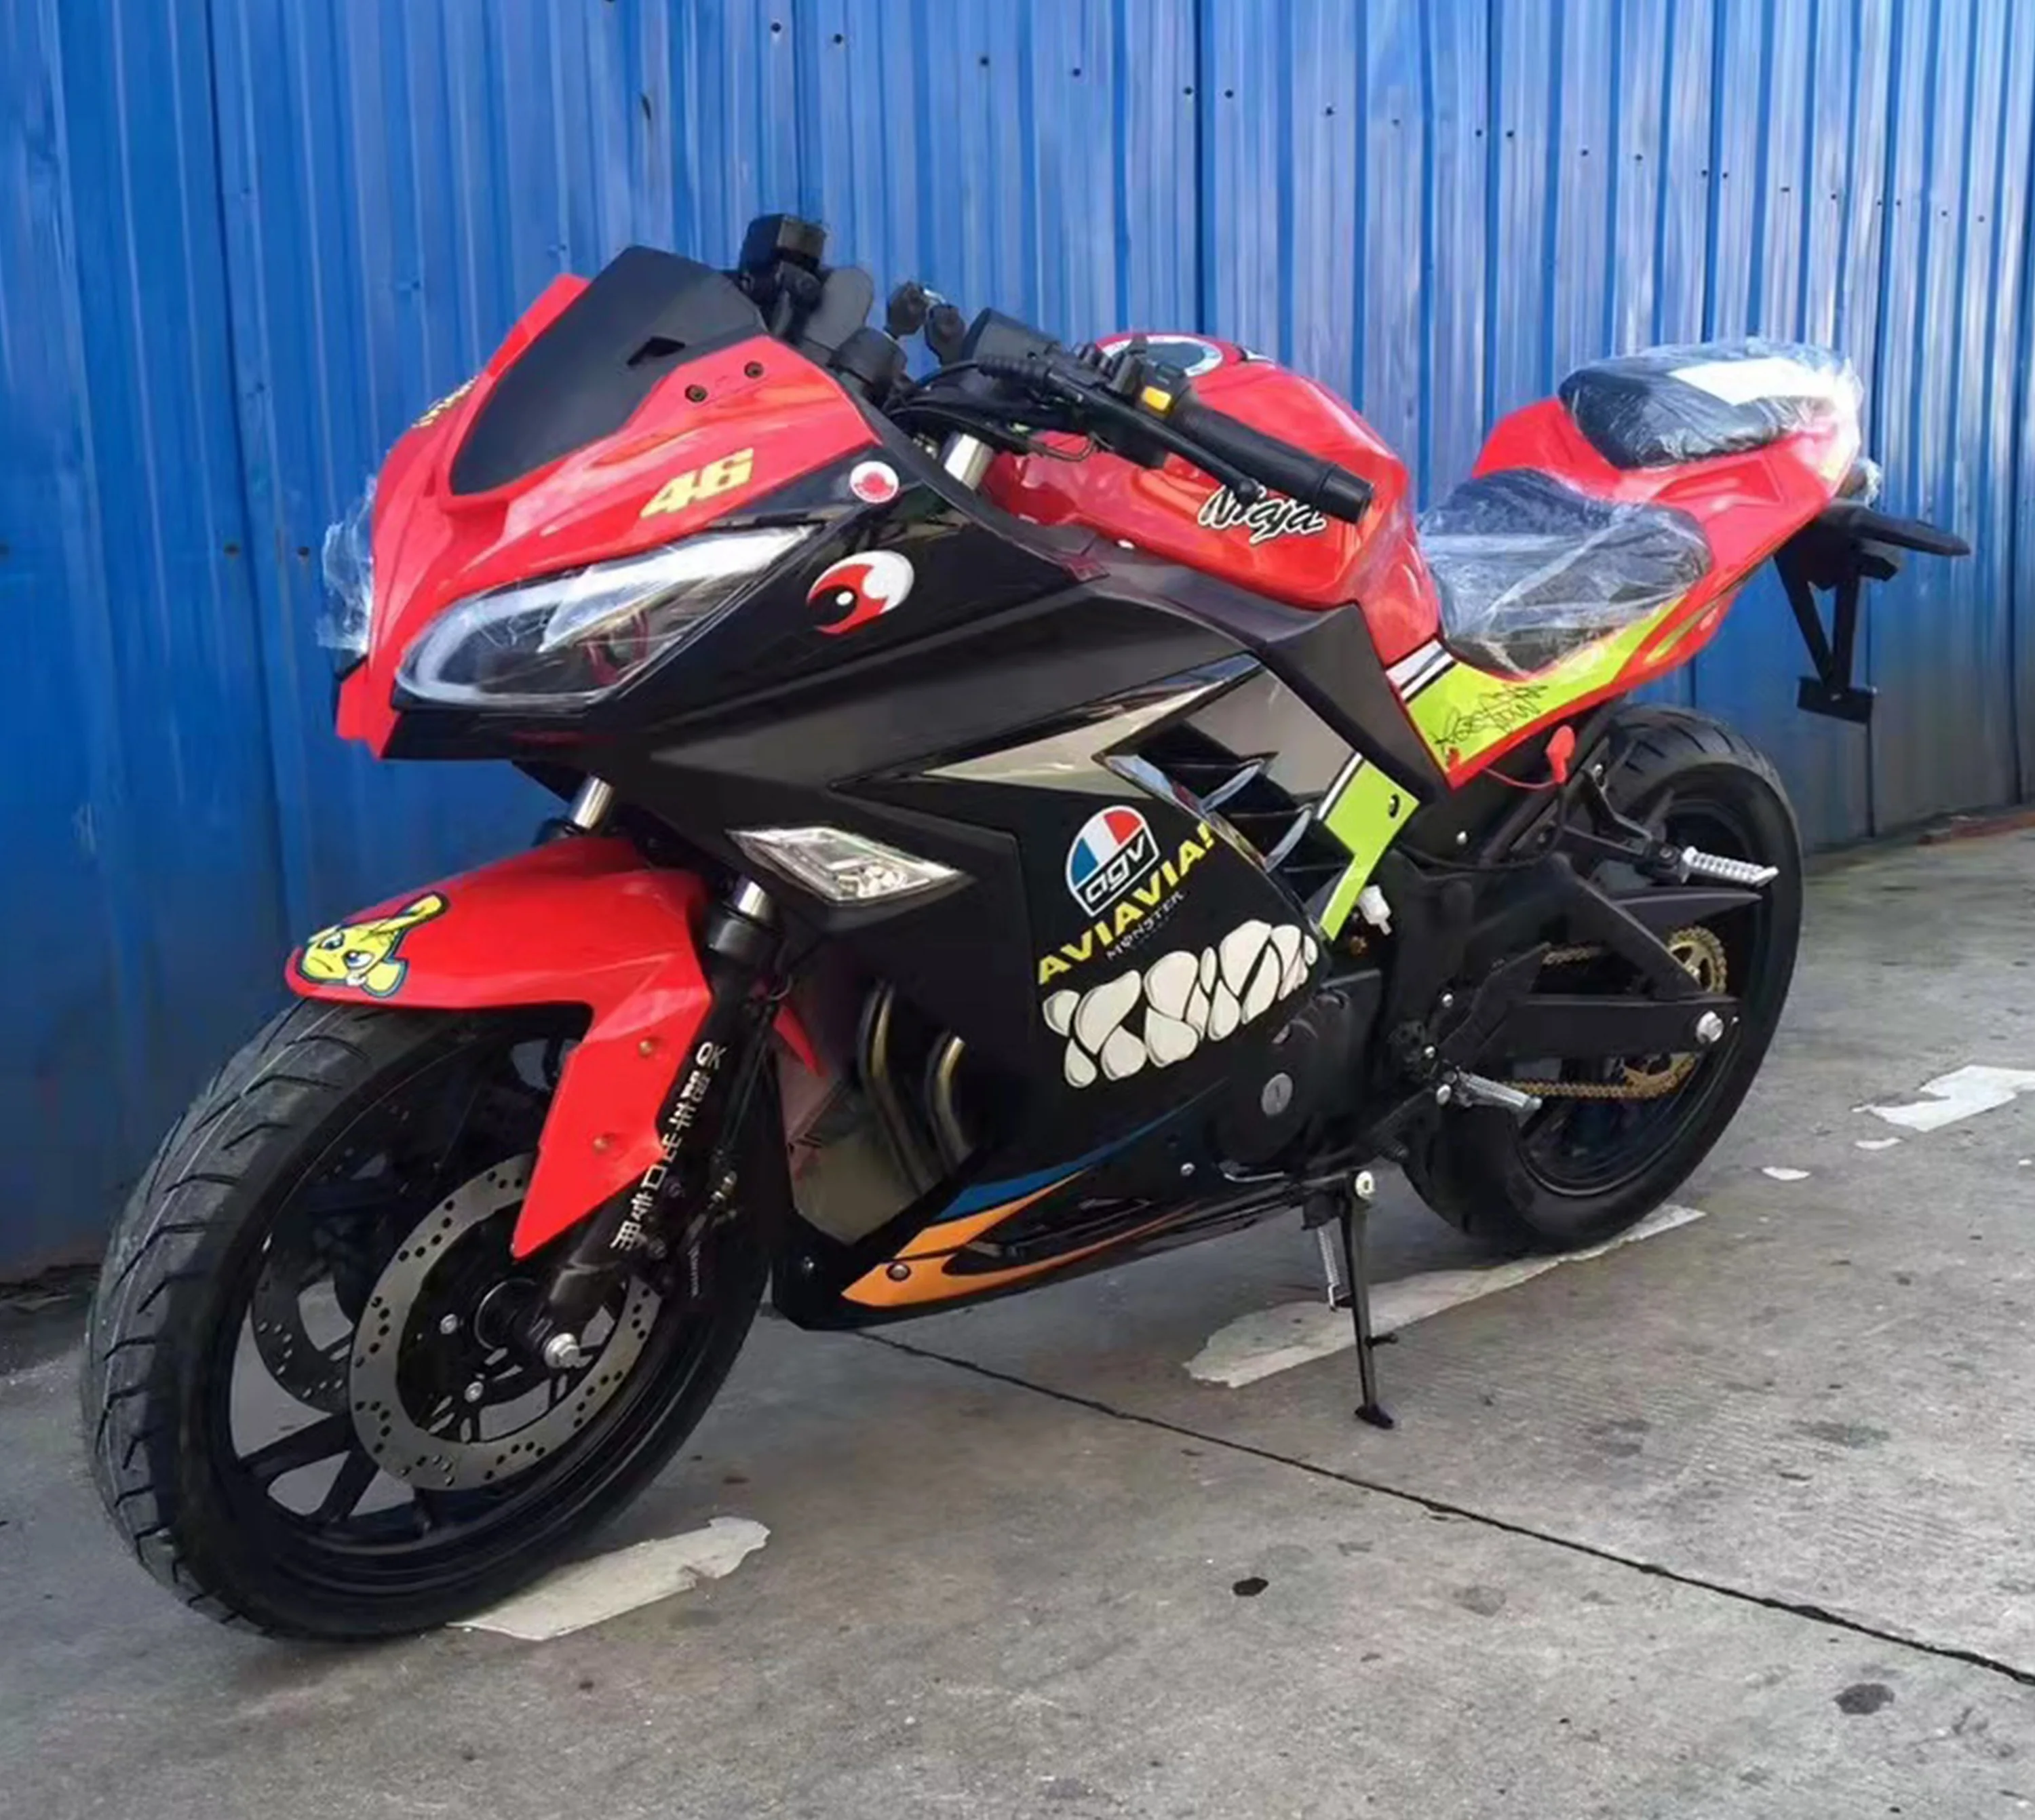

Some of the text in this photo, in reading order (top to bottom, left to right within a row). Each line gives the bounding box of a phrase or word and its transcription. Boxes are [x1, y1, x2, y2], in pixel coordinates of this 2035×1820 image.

[640, 448, 755, 519] 46
[1086, 834, 1146, 904] agv
[1106, 890, 1184, 961] MONSTER
